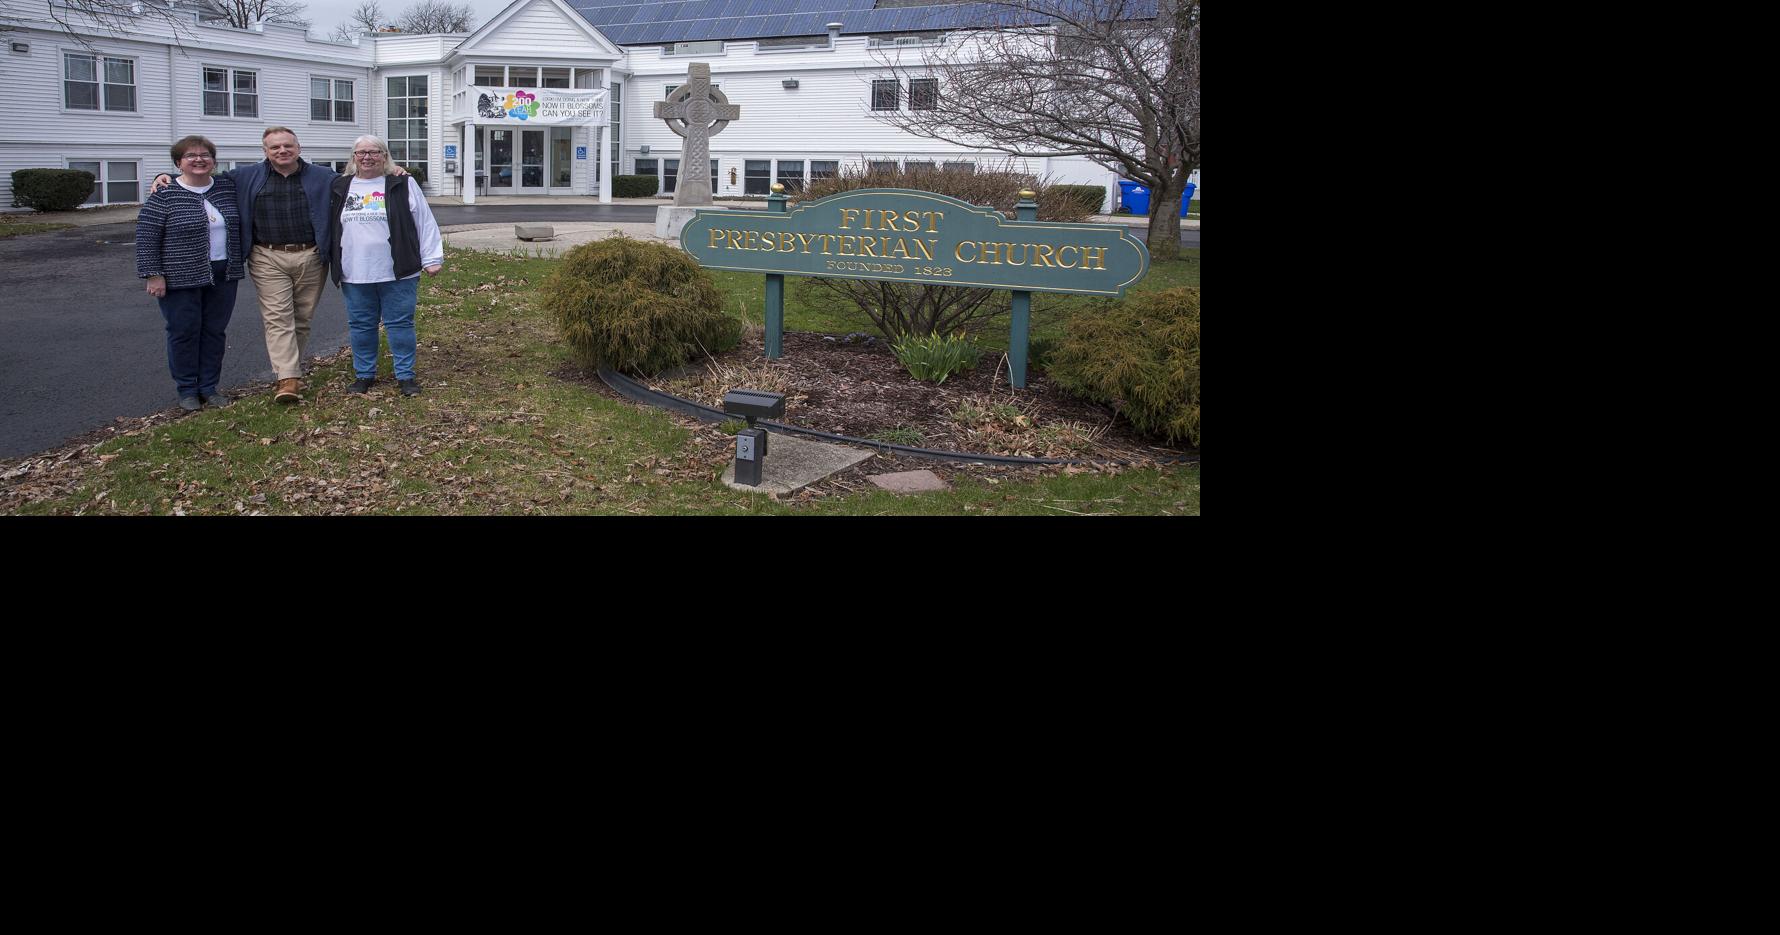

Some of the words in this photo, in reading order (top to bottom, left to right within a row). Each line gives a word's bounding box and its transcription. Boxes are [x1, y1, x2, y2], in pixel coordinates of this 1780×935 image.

[512, 97, 532, 106] 200
[542, 109, 558, 117] CAN
[560, 109, 576, 117] YOU
[578, 110, 591, 118] SEE
[593, 110, 604, 118] IT?
[838, 207, 944, 233] FIRST
[706, 228, 939, 261] PRESBYTERIAN
[954, 240, 1109, 271] CHURCH
[825, 260, 905, 274] FOUNDED
[914, 267, 953, 277] 1823
